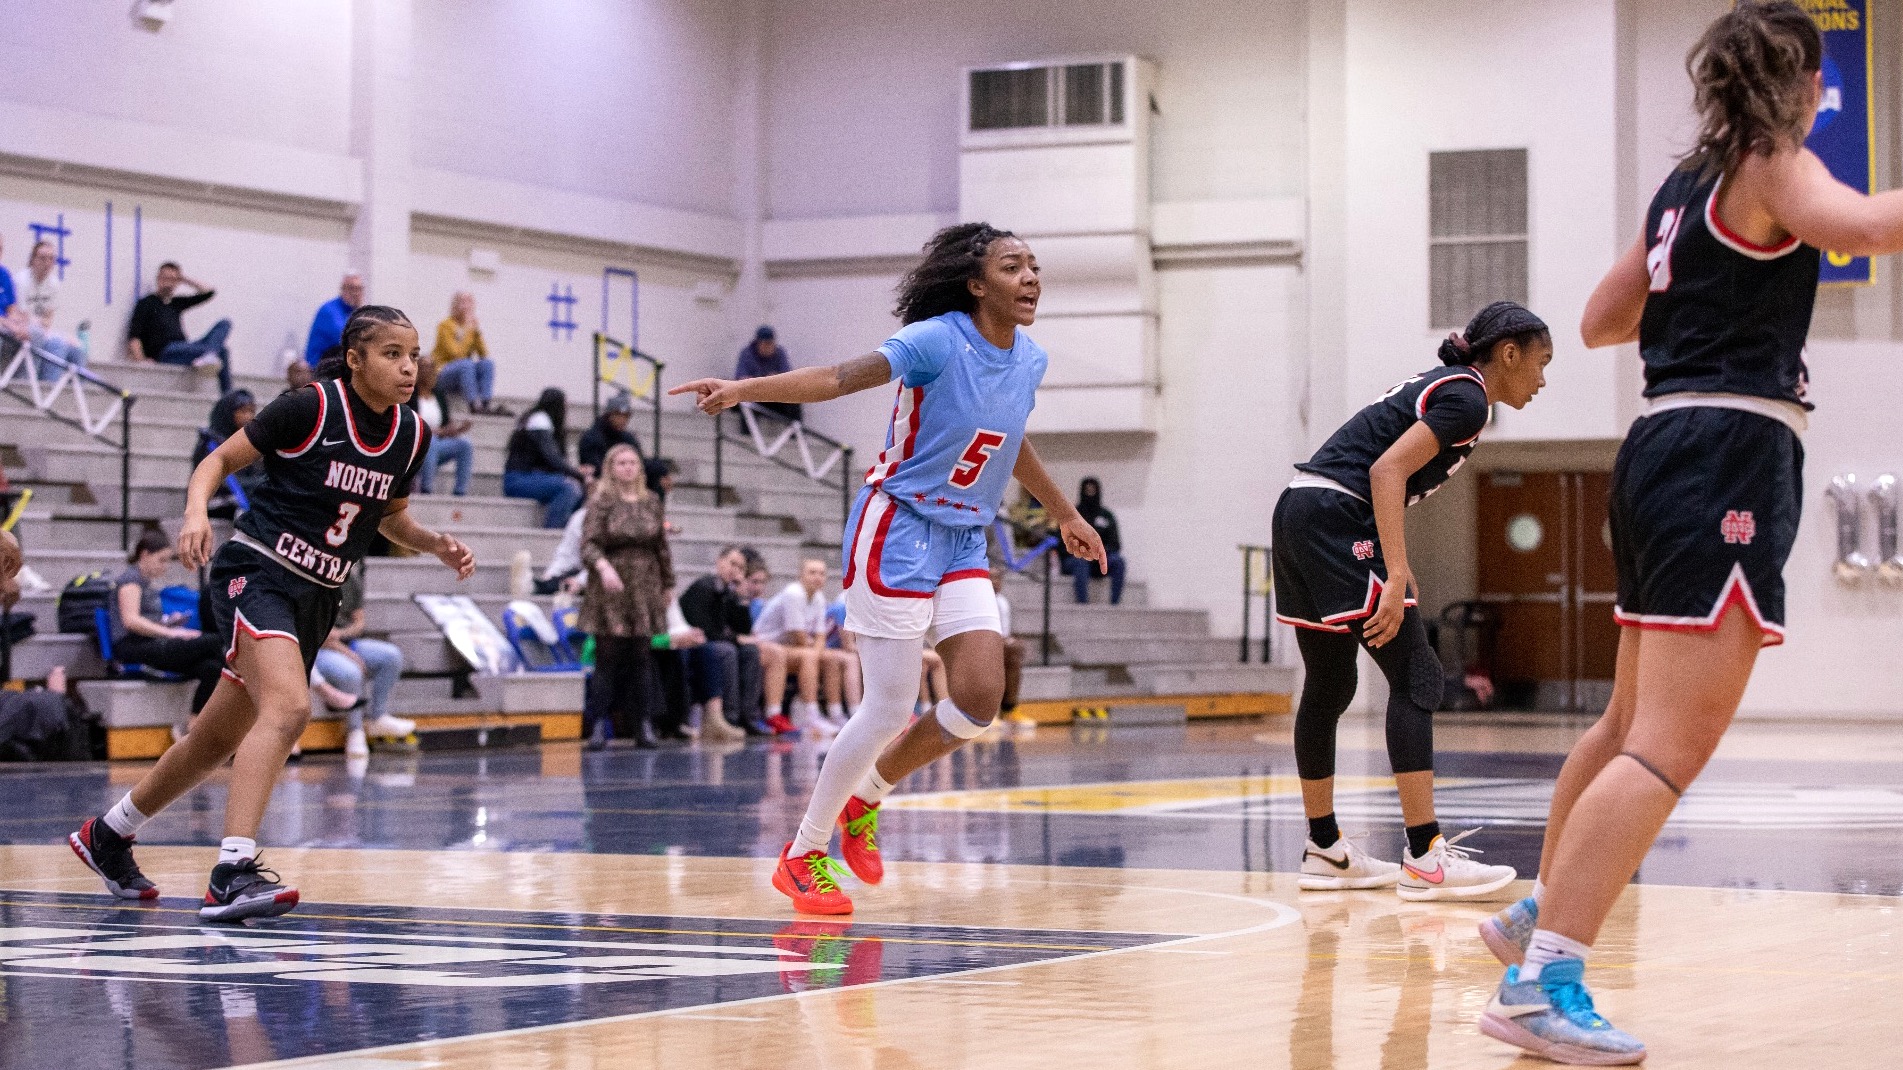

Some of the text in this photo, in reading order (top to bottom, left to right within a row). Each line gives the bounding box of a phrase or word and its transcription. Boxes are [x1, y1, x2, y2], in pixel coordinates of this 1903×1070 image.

[324, 460, 395, 501] NORTH
[947, 428, 1008, 490] 5
[325, 501, 362, 548] 3
[275, 532, 353, 583] CENTRA
